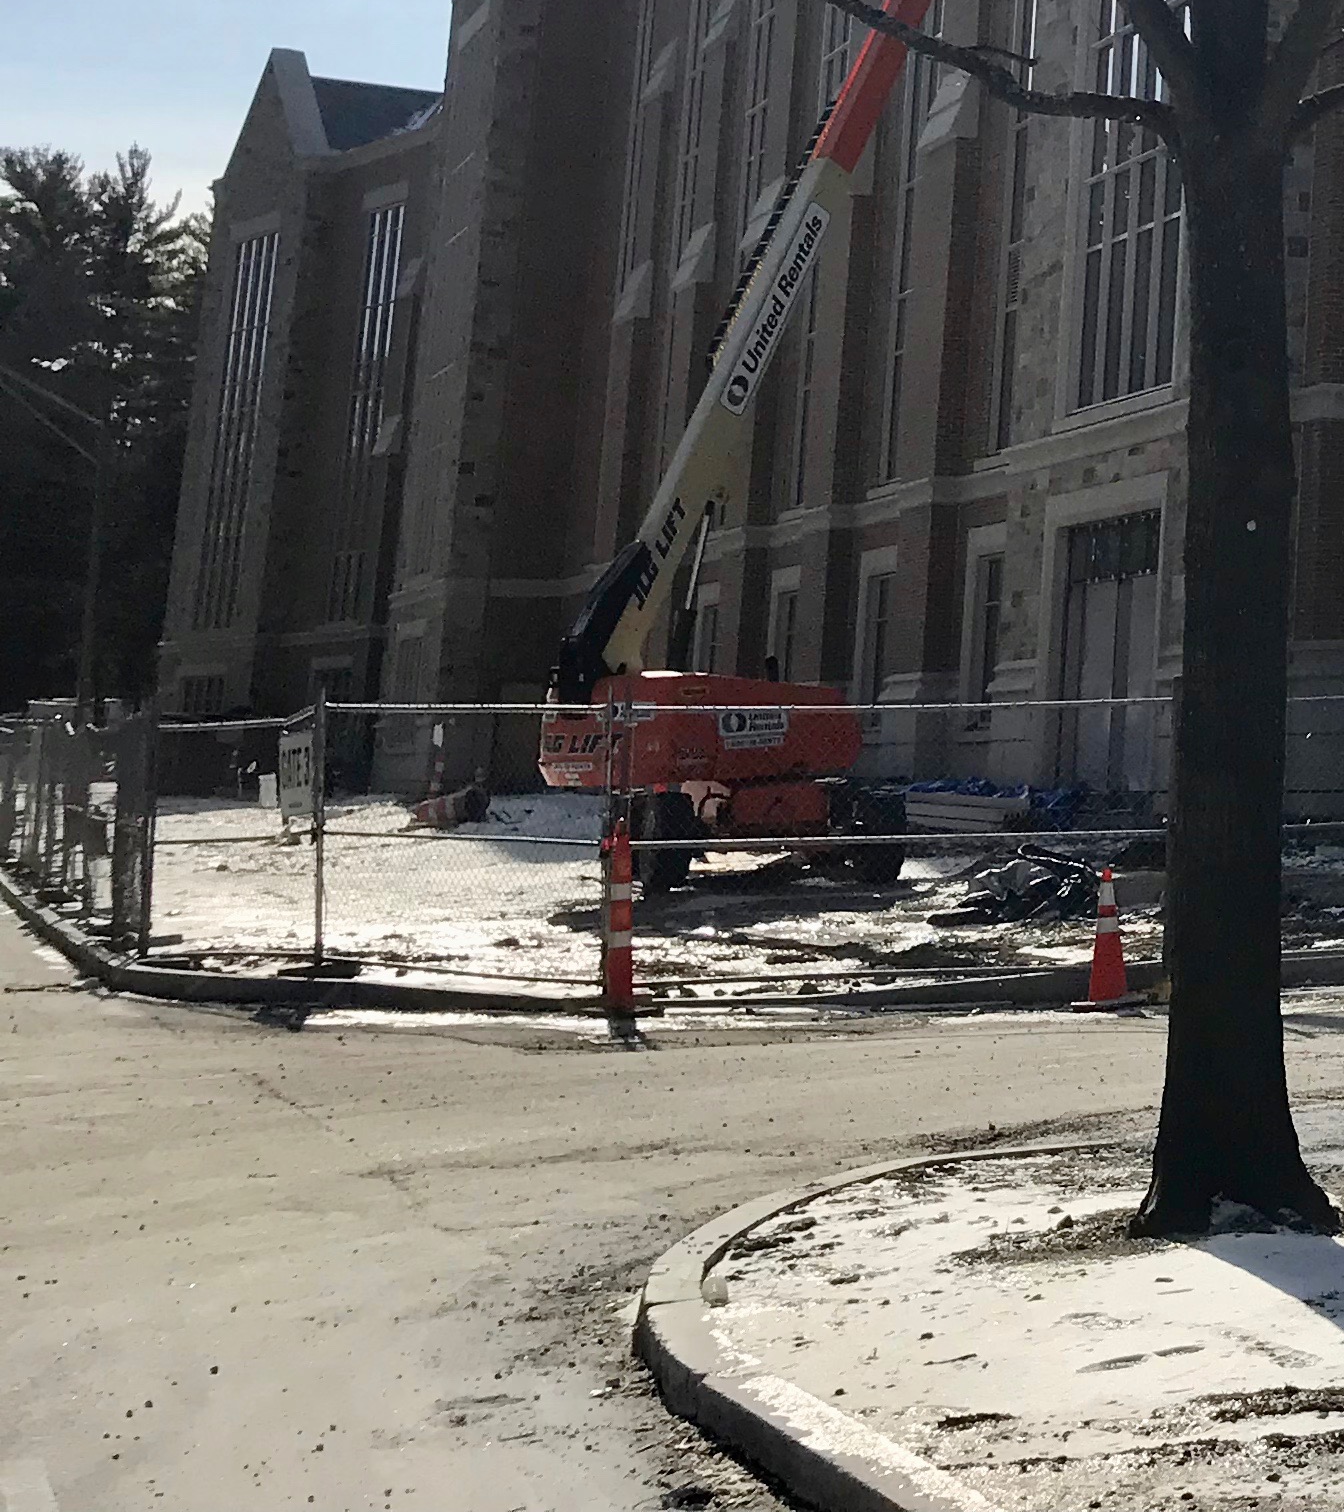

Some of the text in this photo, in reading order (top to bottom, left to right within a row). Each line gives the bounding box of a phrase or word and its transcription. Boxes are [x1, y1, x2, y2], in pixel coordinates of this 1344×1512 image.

[741, 215, 823, 373] United Rentals
[655, 497, 686, 559] LIFT
